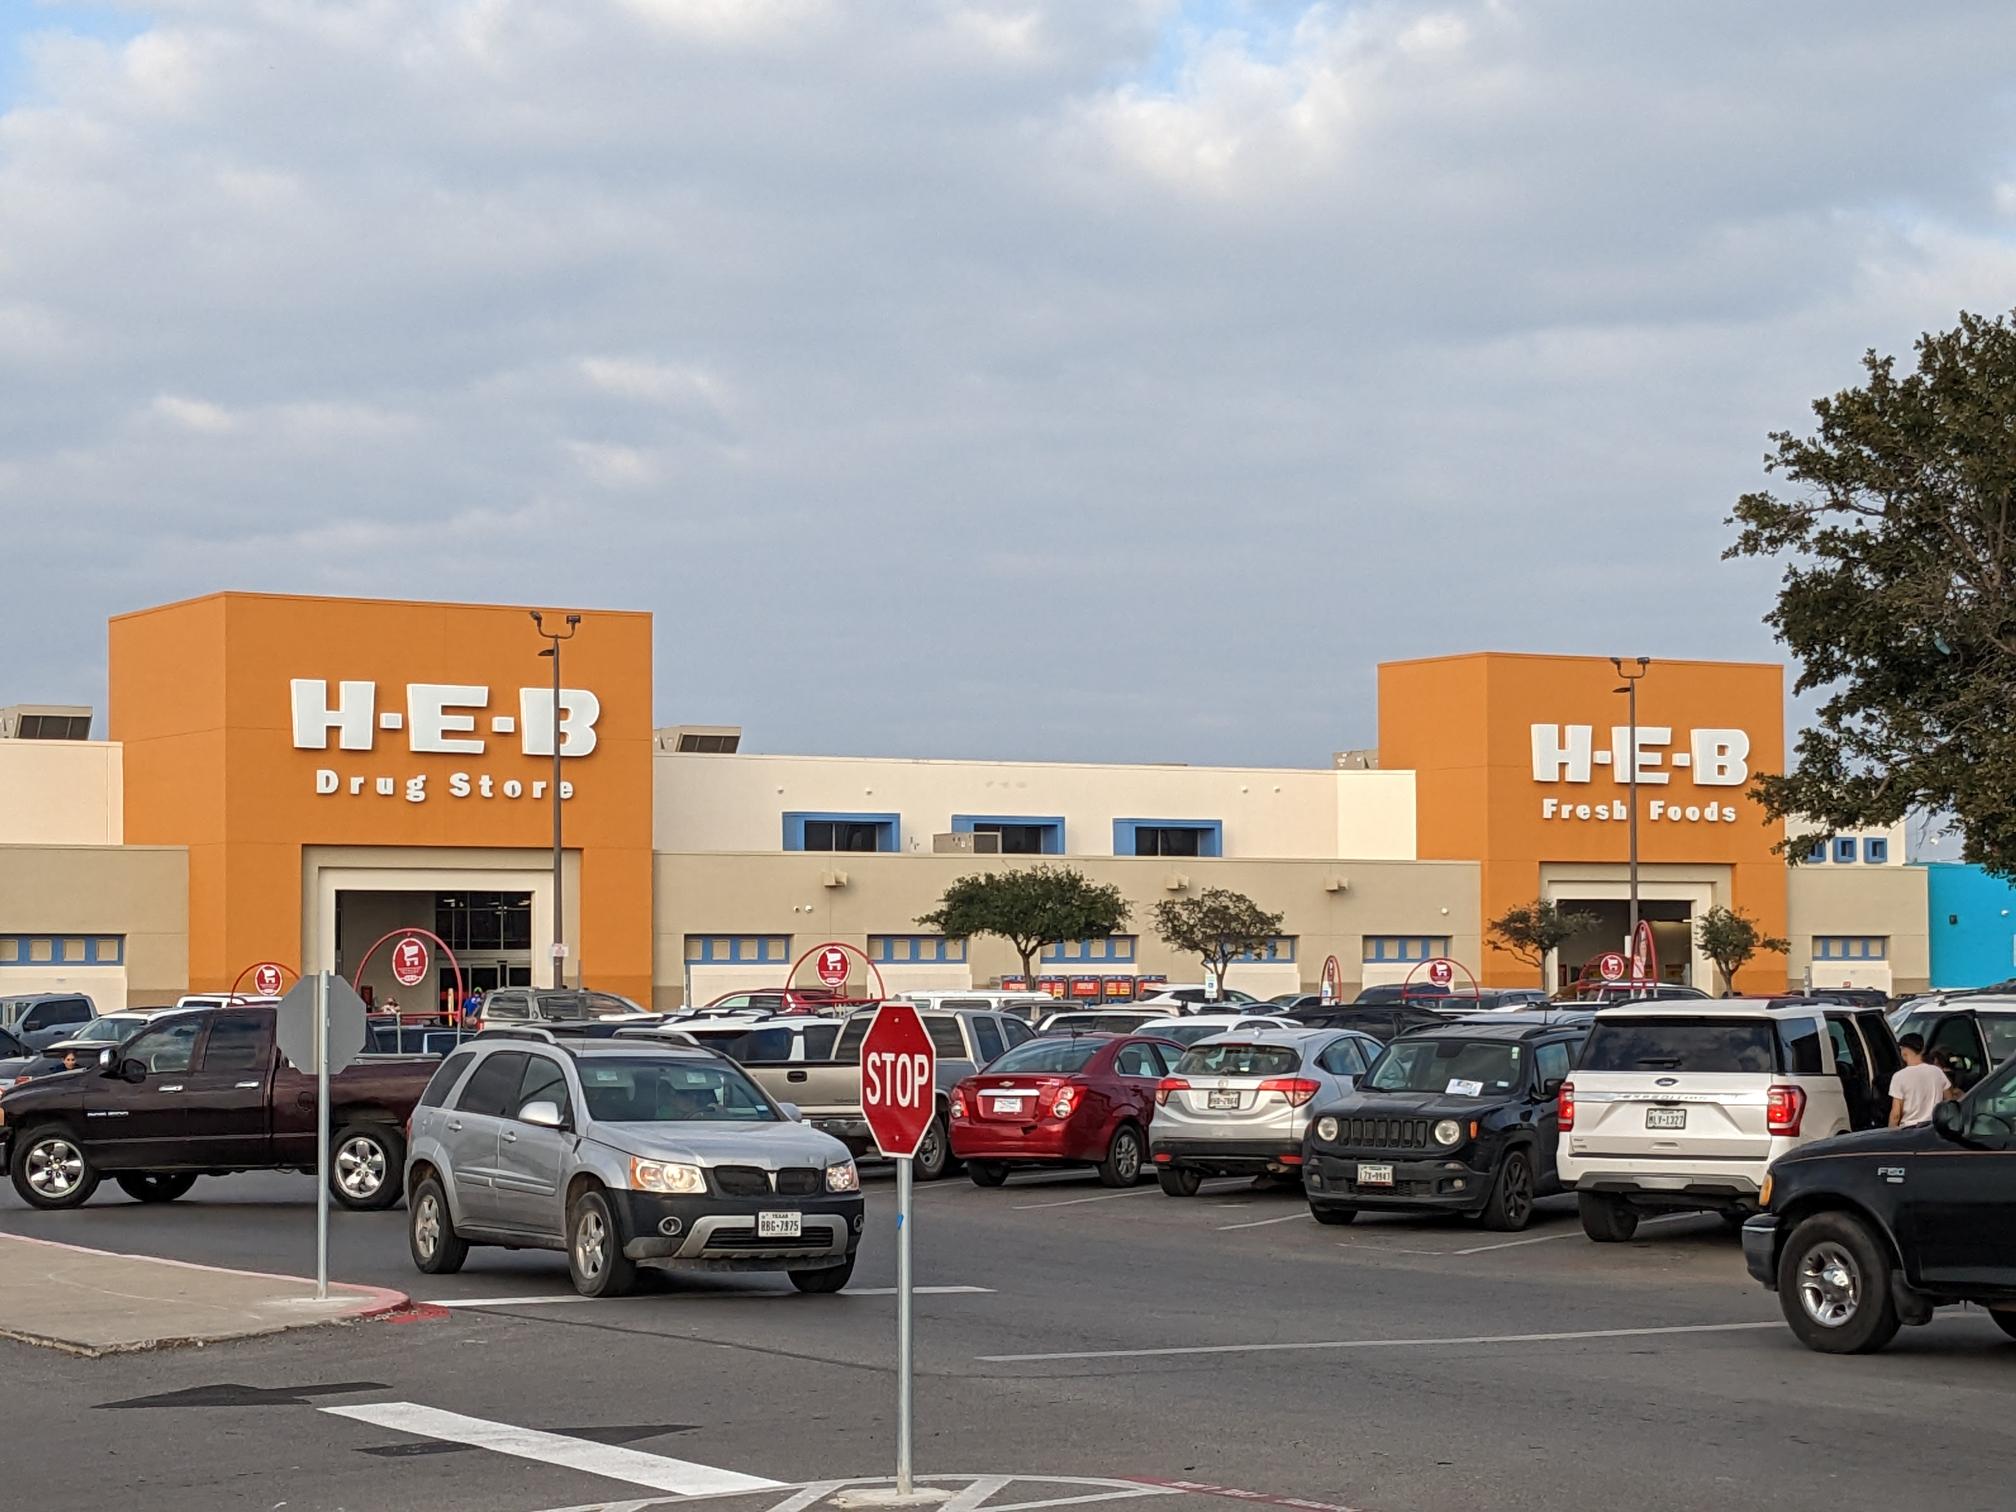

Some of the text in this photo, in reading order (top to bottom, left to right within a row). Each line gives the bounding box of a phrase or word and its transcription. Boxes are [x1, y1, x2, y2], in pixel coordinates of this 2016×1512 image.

[290, 678, 600, 757] H-E-B
[1530, 723, 1750, 786] H-E-B
[316, 769, 574, 802] Drug Store
[1542, 798, 1736, 822] Fresh Foods
[865, 1051, 930, 1107] STOP
